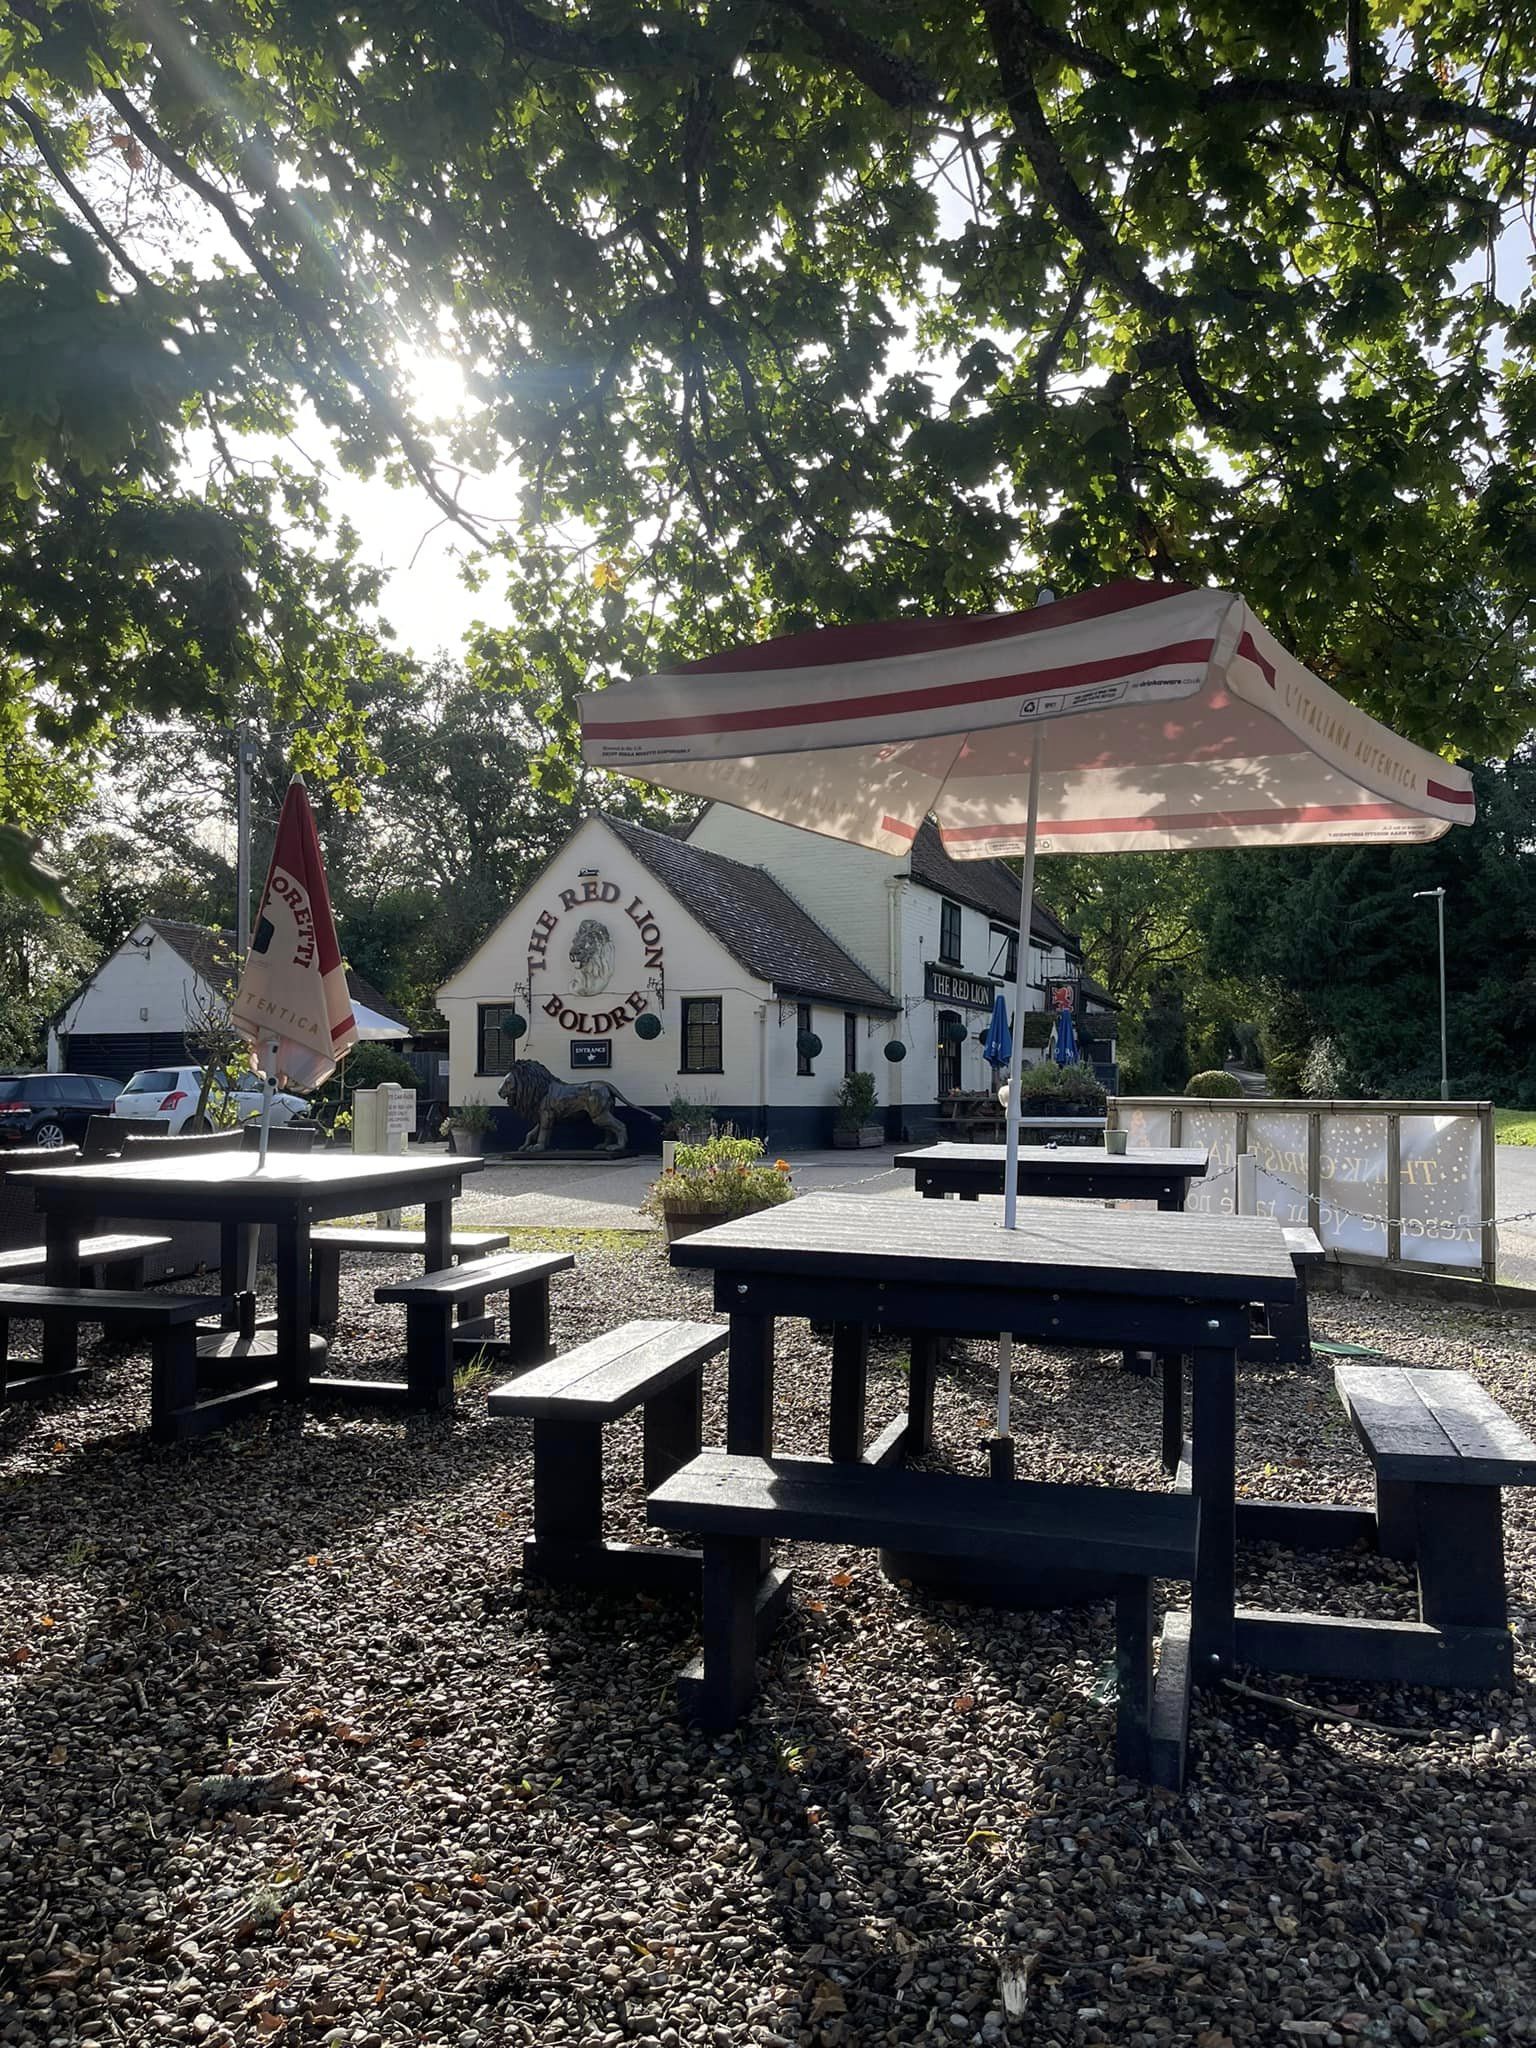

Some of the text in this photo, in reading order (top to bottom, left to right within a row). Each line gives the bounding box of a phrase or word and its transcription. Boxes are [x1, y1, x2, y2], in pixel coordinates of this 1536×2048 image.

[1285, 684, 1417, 792] L'ITALIANA AUTENTICA
[264, 876, 315, 969] ORETTI
[528, 881, 664, 977] THE RED LION
[542, 991, 648, 1034] BOLDRE
[933, 972, 990, 1005] THE RED LION
